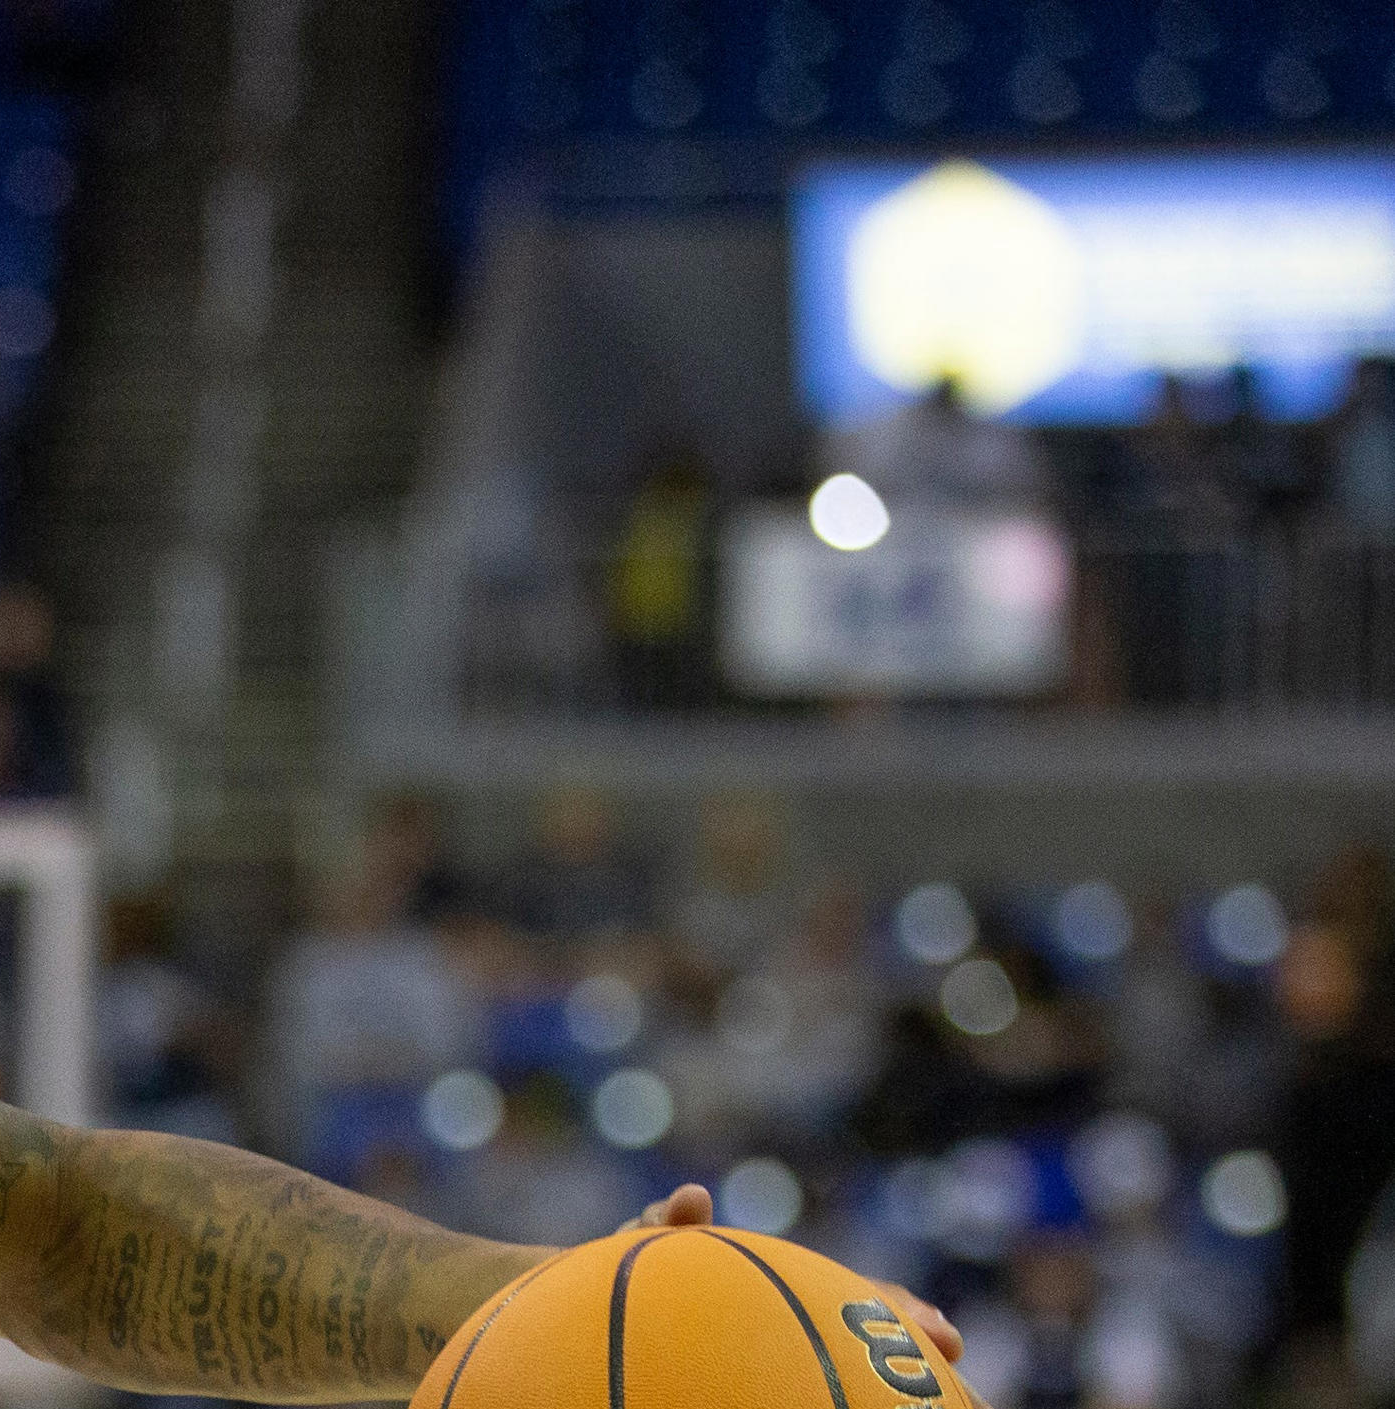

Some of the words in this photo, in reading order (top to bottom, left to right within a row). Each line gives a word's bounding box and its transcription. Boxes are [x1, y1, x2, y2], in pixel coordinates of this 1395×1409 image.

[107, 1231, 140, 1350] GOD
[188, 1216, 225, 1375] TRUST
[257, 1250, 287, 1363] YOU
